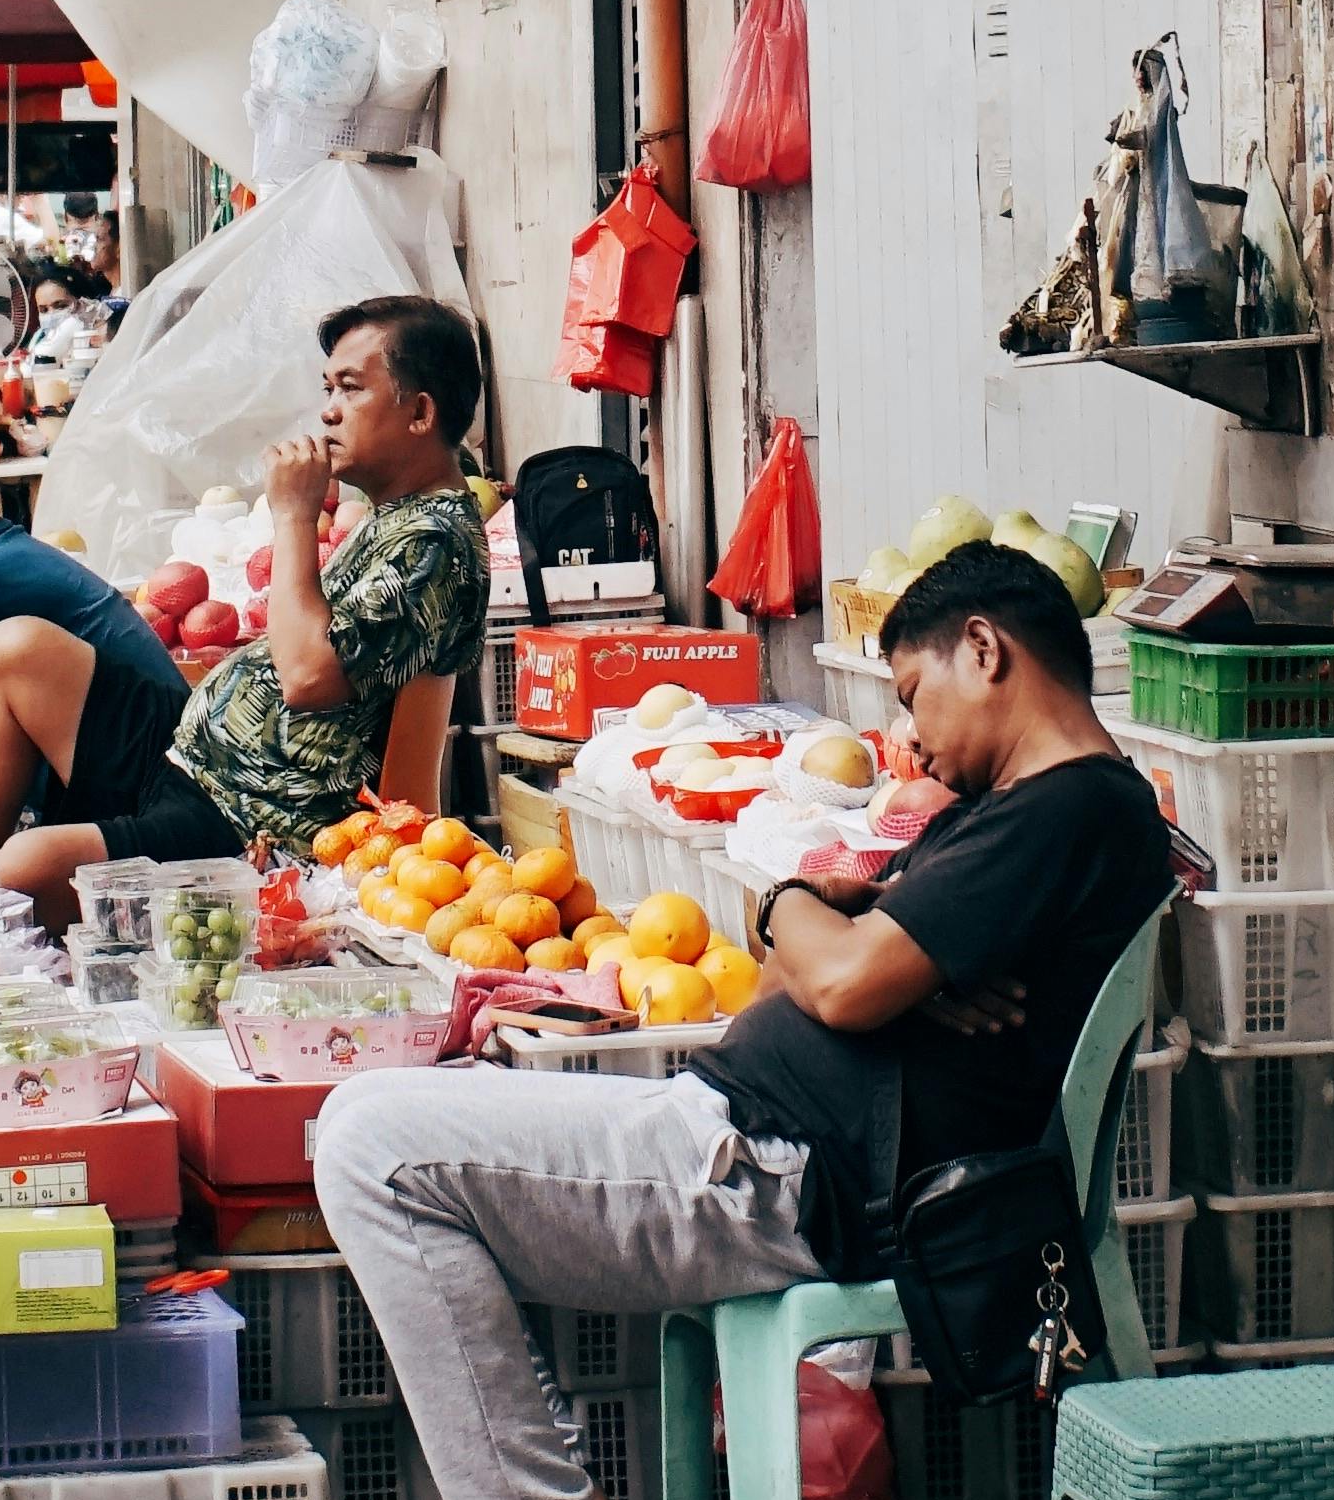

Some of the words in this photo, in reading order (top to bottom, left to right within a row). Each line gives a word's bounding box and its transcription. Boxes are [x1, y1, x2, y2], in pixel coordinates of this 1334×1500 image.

[558, 548, 592, 566] CAT
[642, 646, 681, 661] FUJI
[683, 645, 738, 660] APPLE
[536, 654, 554, 678] FUJI
[529, 686, 554, 712] APPLE
[16, 1191, 29, 1202] 12
[42, 1189, 54, 1199] 10
[69, 1187, 76, 1197] 8
